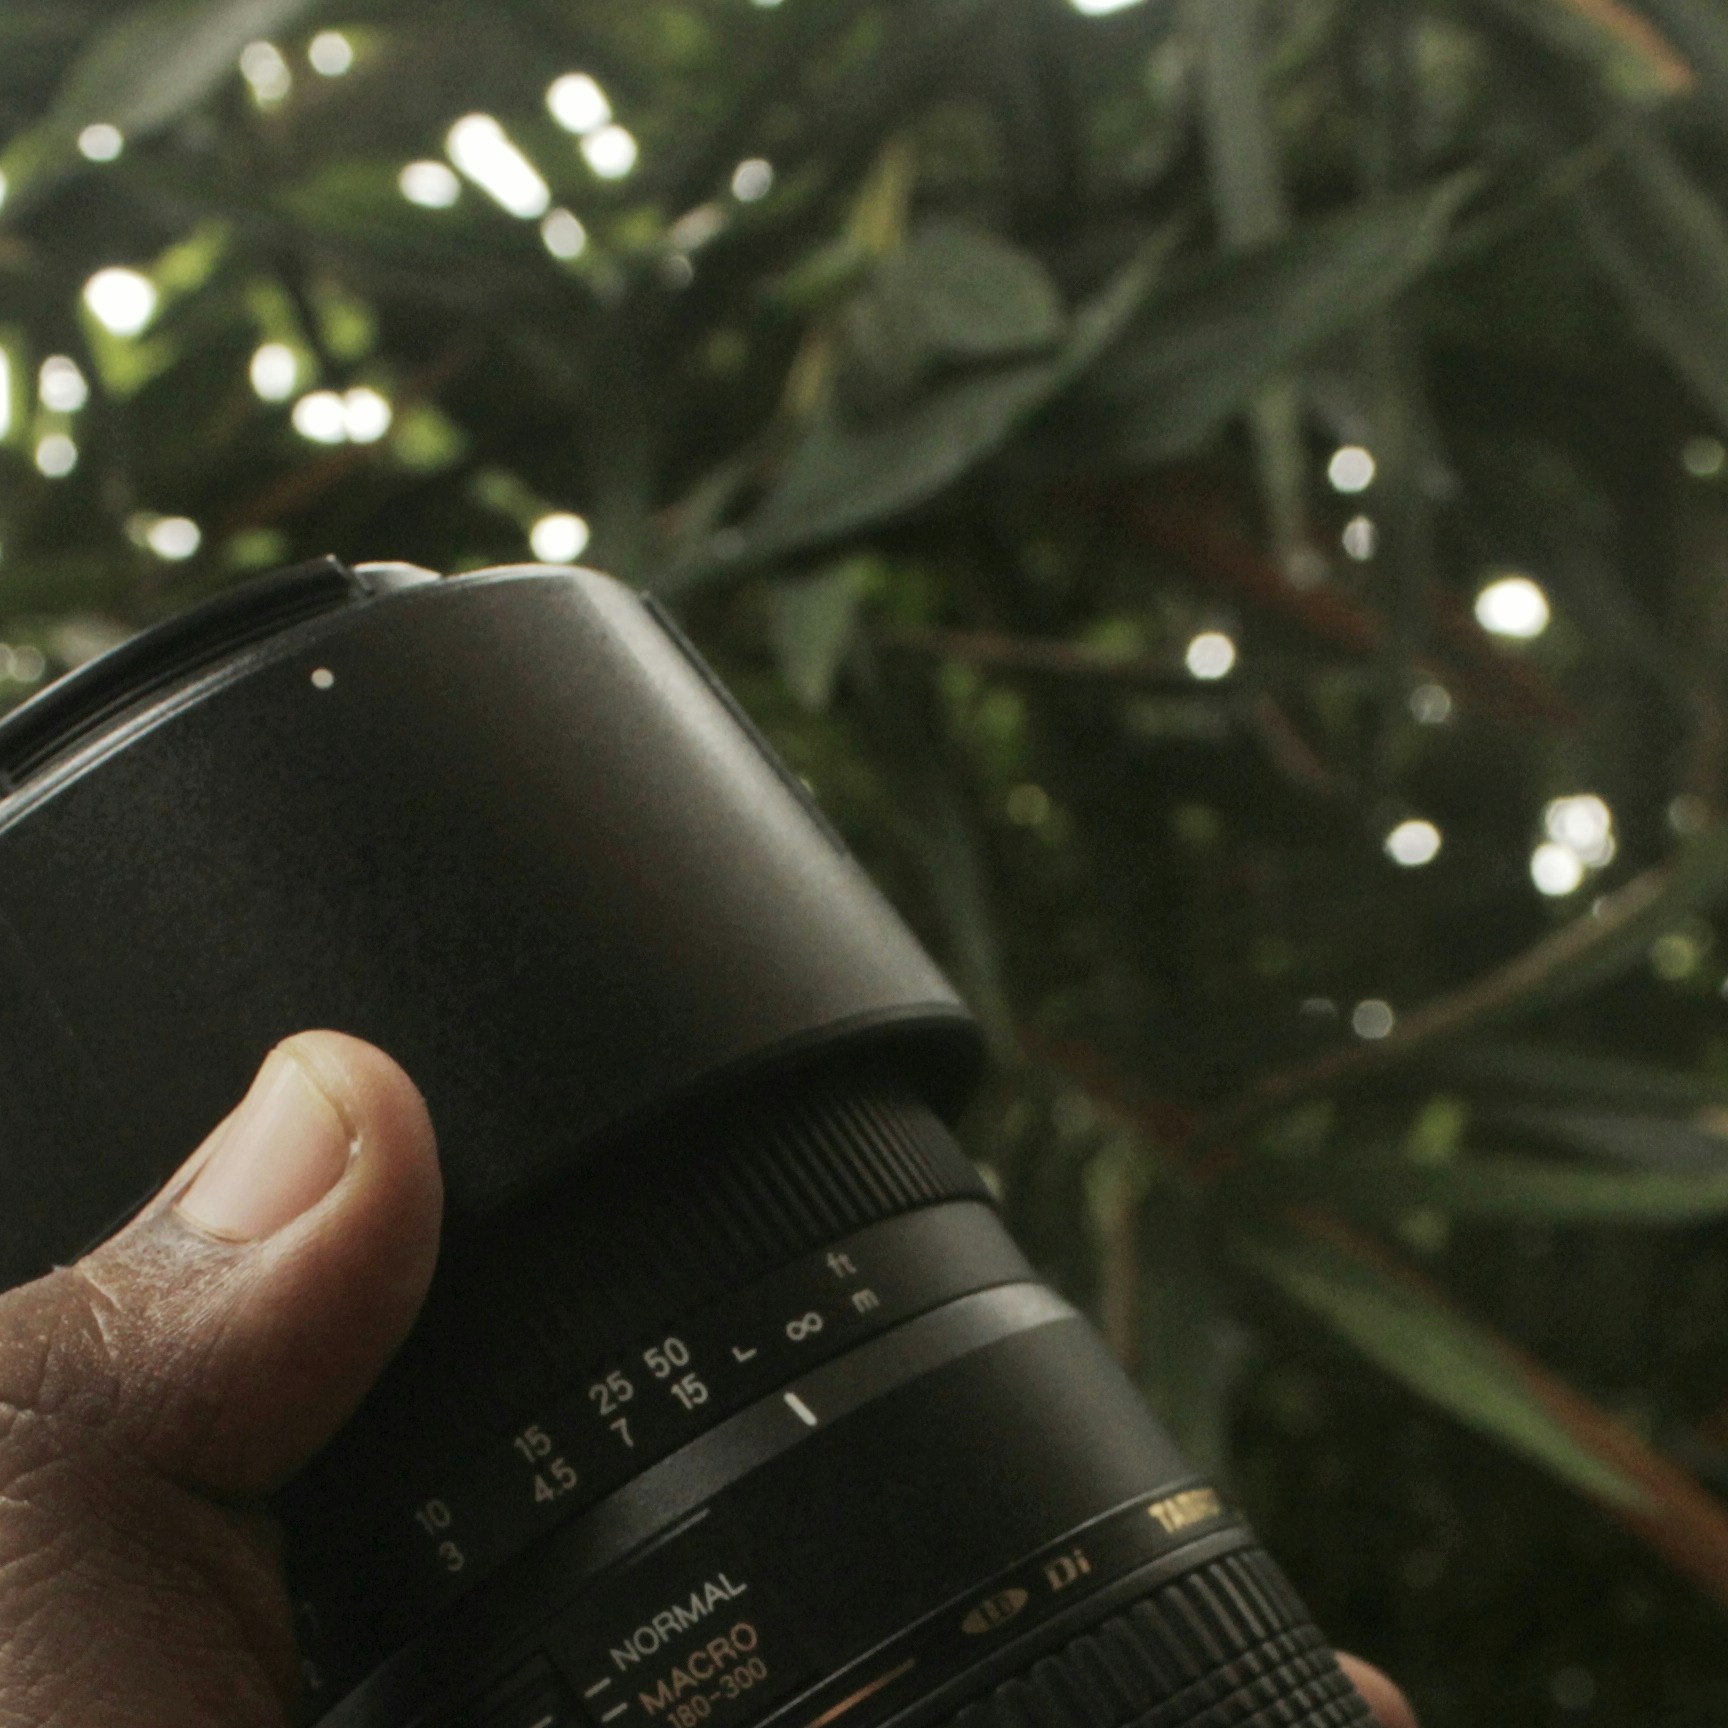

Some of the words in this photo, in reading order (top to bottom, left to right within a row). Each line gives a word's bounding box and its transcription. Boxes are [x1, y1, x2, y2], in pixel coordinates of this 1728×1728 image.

[415, 1497, 452, 1537] 10
[514, 1425, 554, 1466] 15
[588, 1370, 635, 1416] 25
[643, 1336, 691, 1381] 50
[825, 1251, 858, 1279] ft
[438, 1541, 466, 1573] 3
[532, 1458, 579, 1506] 4.5
[609, 1416, 636, 1449] 7
[670, 1373, 710, 1411] 15
[850, 1287, 881, 1313] m
[1044, 1548, 1093, 1592] Di
[609, 1571, 748, 1672] NORMAL
[638, 1621, 760, 1717] MACRO
